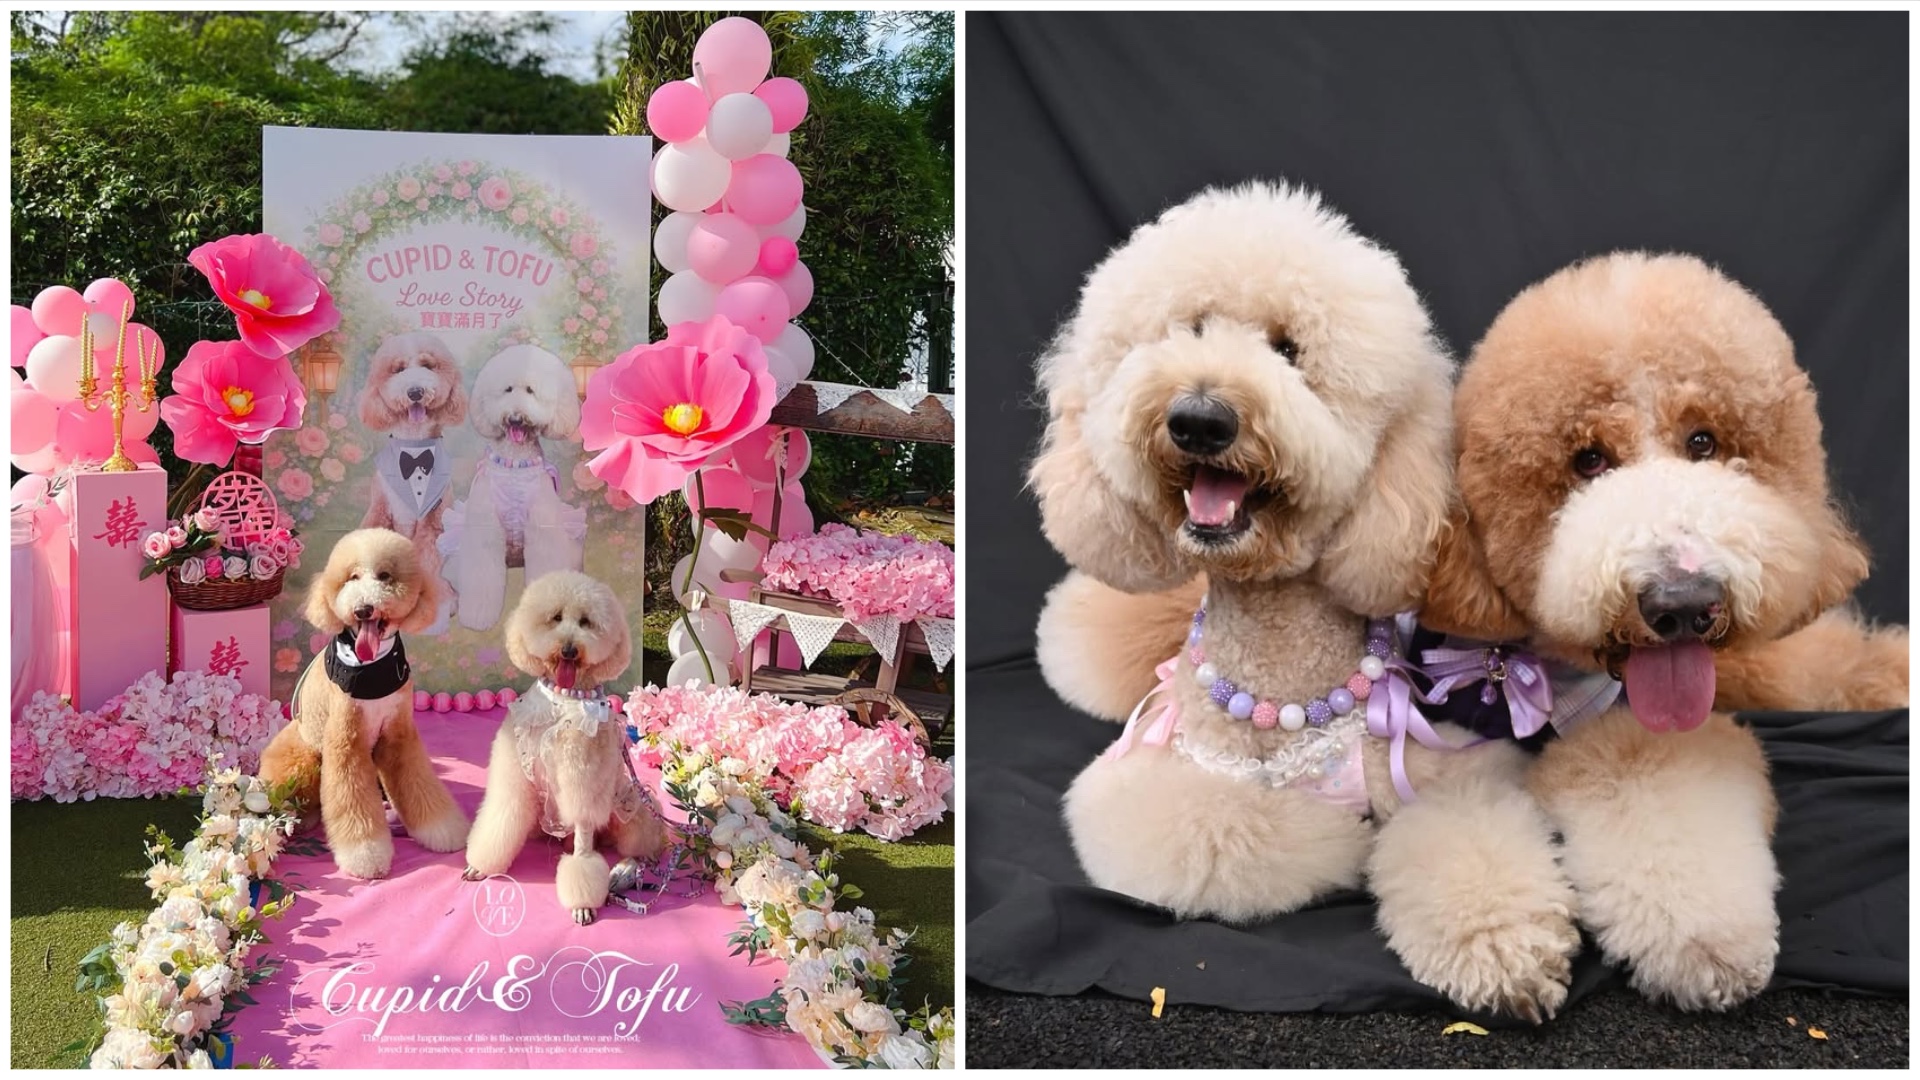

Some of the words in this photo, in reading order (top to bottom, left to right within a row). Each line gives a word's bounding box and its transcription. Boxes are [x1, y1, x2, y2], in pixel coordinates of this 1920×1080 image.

[367, 244, 451, 283] CUPID
[458, 249, 475, 270] &
[483, 246, 553, 286] TOFU
[396, 282, 453, 308] Love
[459, 281, 524, 319] Story
[420, 311, 502, 329] 寶寶滿月了
[93, 496, 147, 549] 囍
